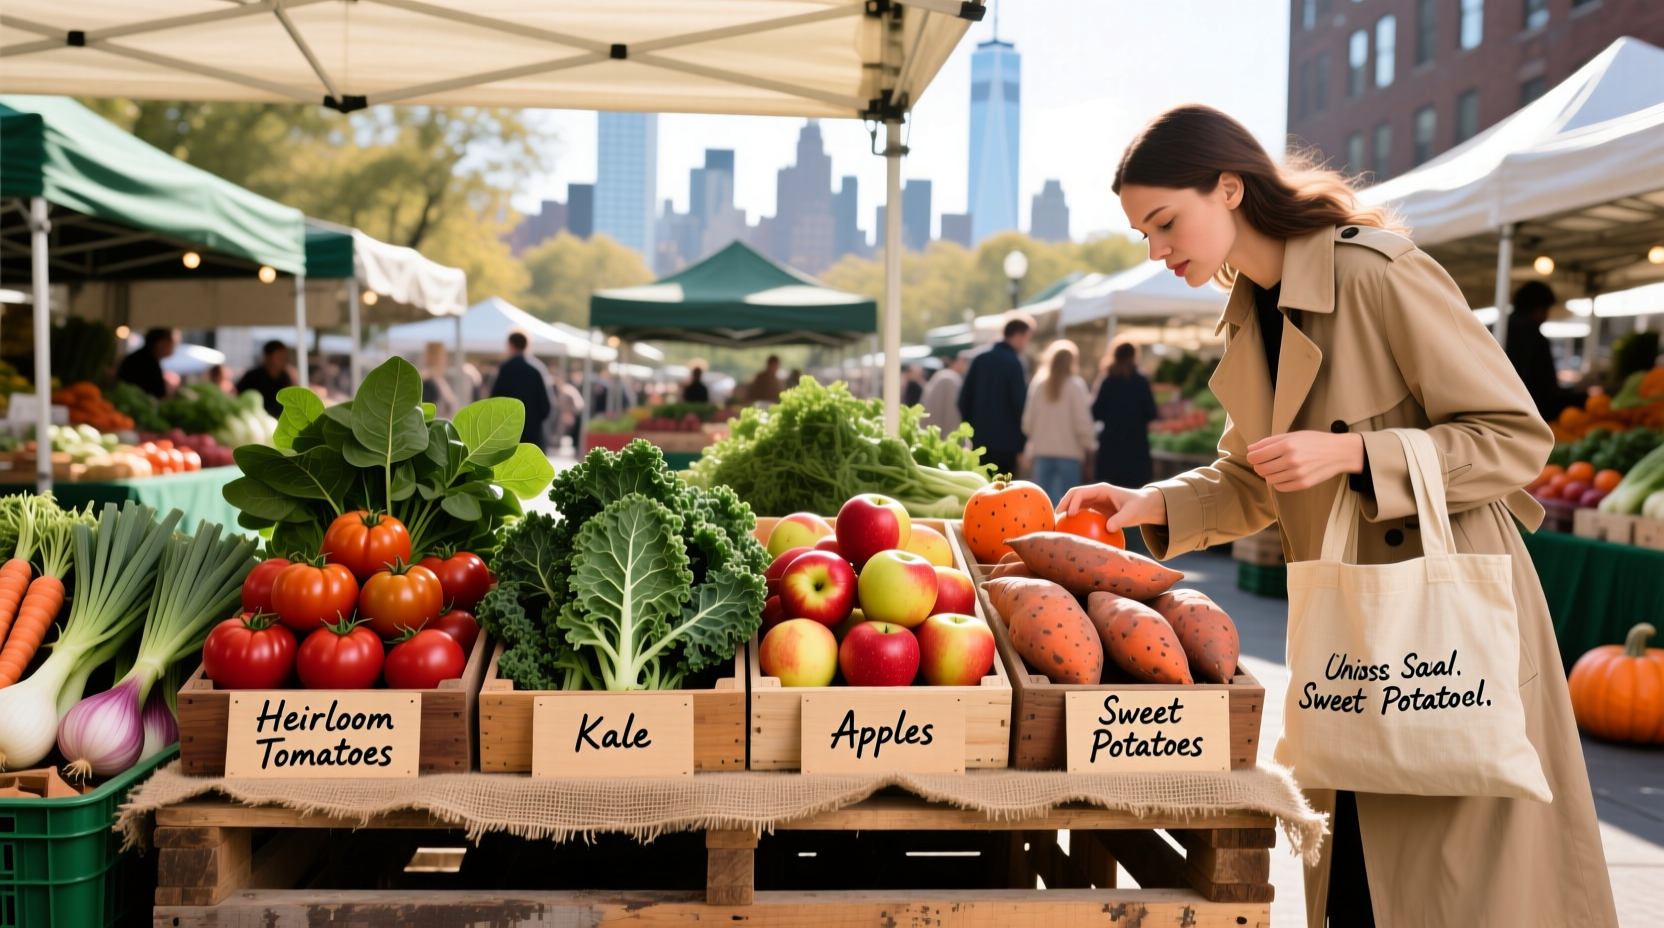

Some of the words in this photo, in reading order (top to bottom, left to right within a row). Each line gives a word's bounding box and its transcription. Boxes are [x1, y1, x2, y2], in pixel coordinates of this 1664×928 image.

[1098, 694, 1184, 726] Sweet
[1298, 681, 1368, 714] Sweet
[256, 699, 394, 733] Heirloom
[574, 712, 652, 753] Kale
[830, 709, 934, 760] Apples
[1089, 728, 1204, 764] Potatoes
[256, 737, 393, 770] Tomatoes
